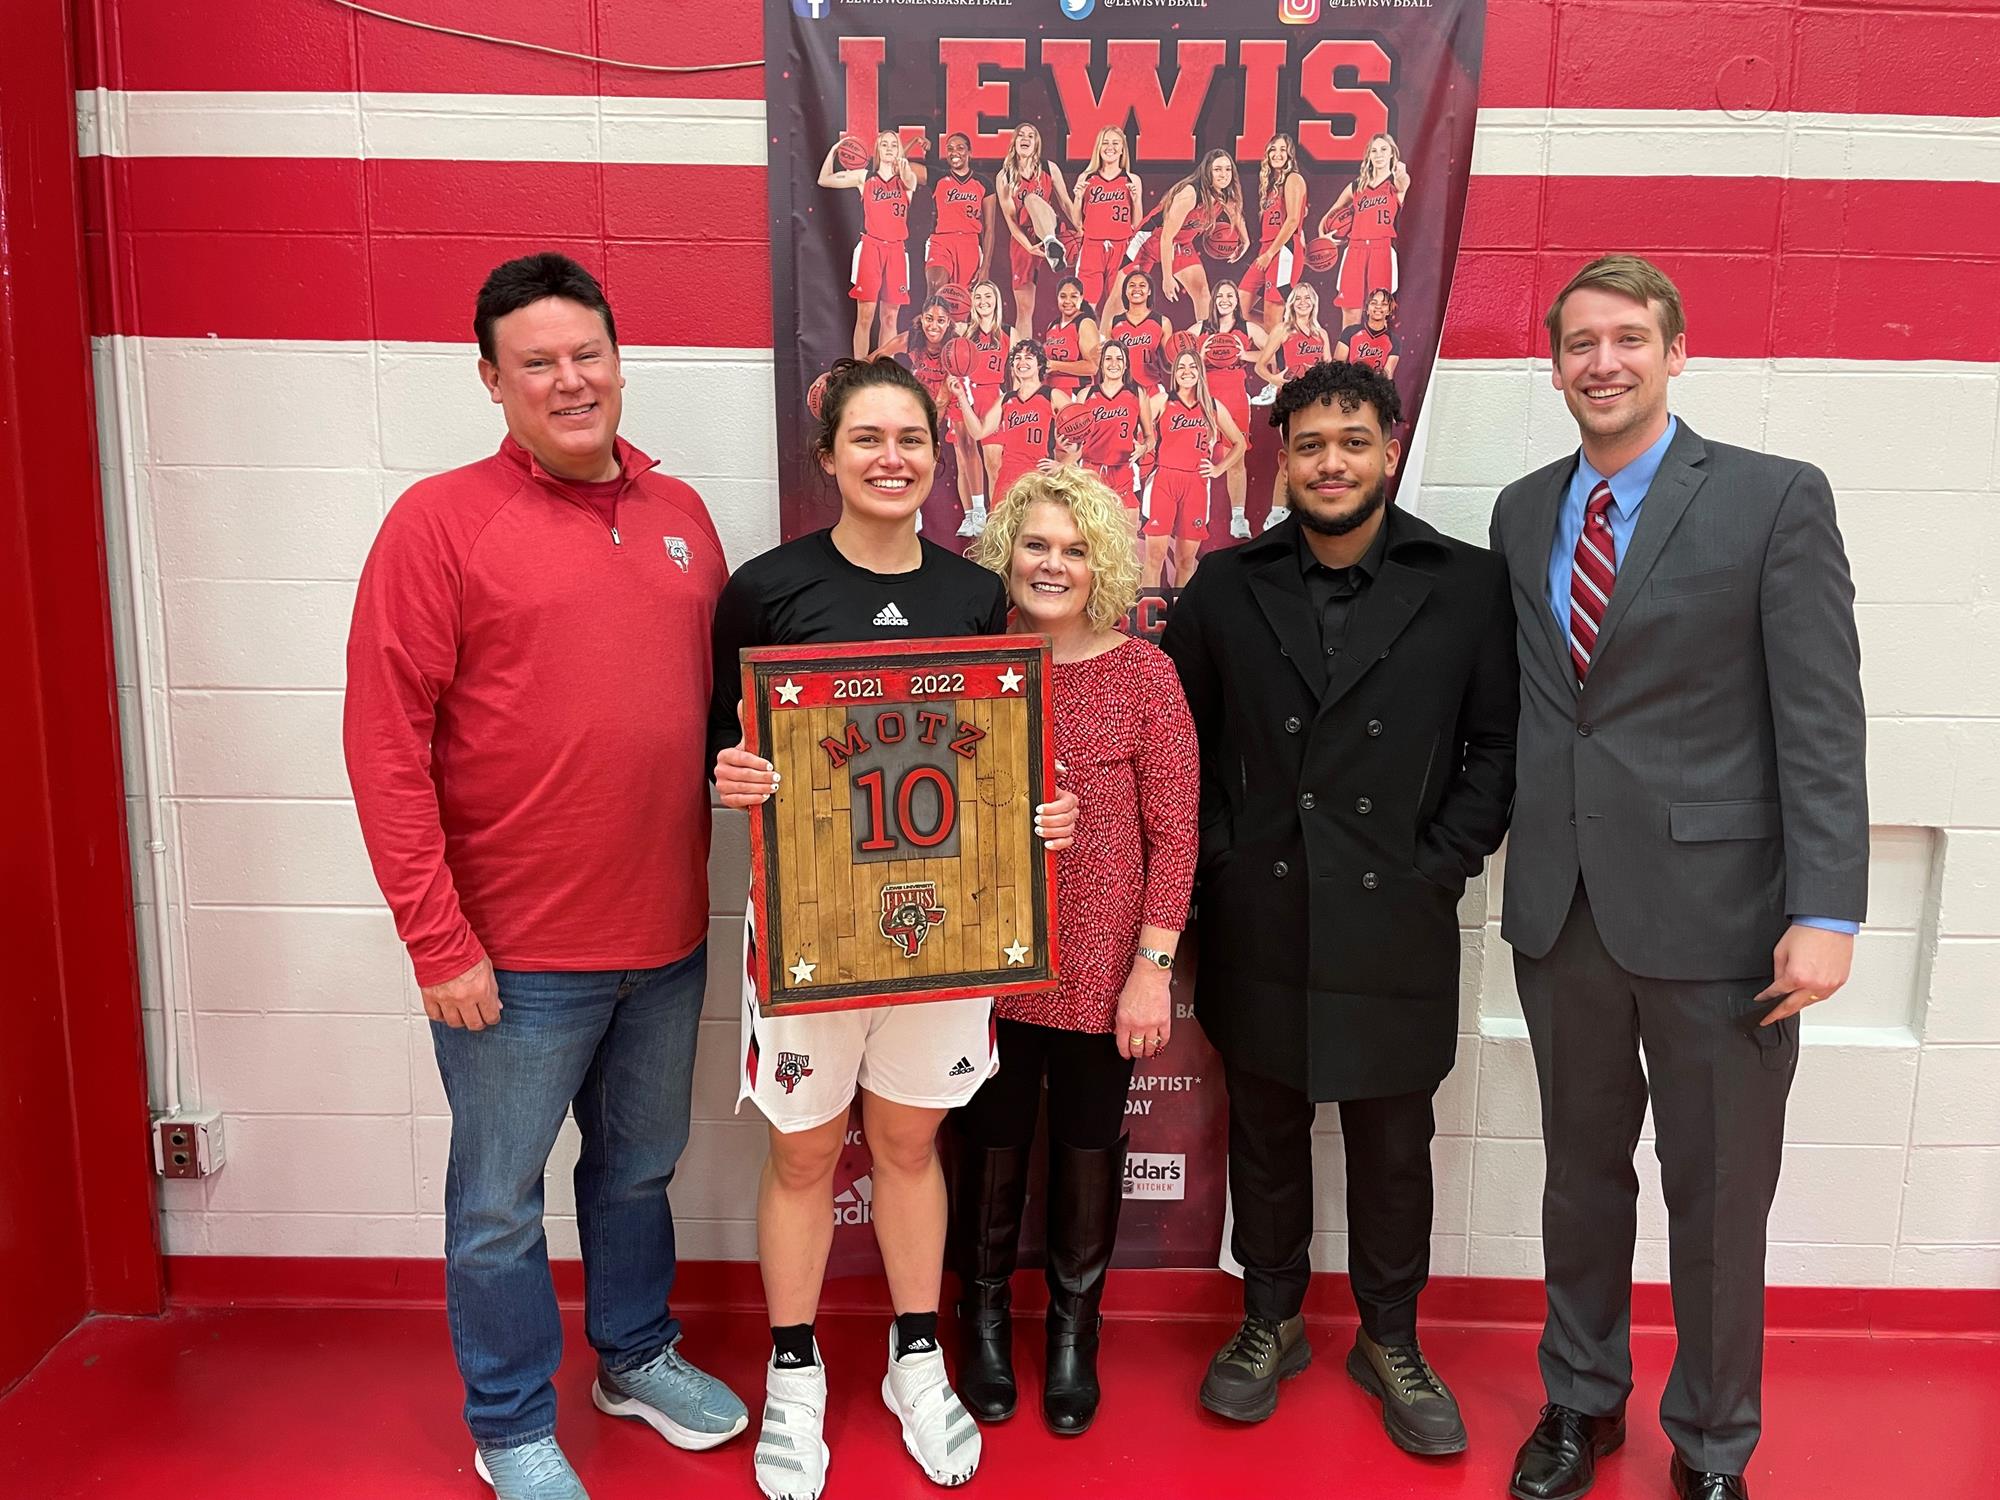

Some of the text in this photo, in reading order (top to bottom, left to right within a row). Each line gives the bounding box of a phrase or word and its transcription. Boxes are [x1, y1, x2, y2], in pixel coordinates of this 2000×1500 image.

[838, 36, 1392, 161] LEWIS
[946, 188, 978, 203] Lewis
[1088, 185, 1126, 204] Lewis
[1357, 194, 1388, 213] Lewis
[1111, 205, 1130, 223] 32
[1376, 209, 1392, 225] 15
[1118, 331, 1152, 347] Lewis
[988, 354, 1002, 372] 21
[1008, 410, 1039, 429] Lewis
[1092, 406, 1129, 422] Lewis
[1026, 427, 1043, 444] 10
[1119, 422, 1129, 439] 3
[872, 617, 909, 626] adidas
[833, 673, 965, 699] 2021 2022
[819, 710, 987, 769] MOTZ
[856, 765, 957, 851] 10
[883, 890, 935, 911] FLYERS
[948, 1066, 976, 1077] adidas
[1136, 1183, 1173, 1192] KITCHEN
